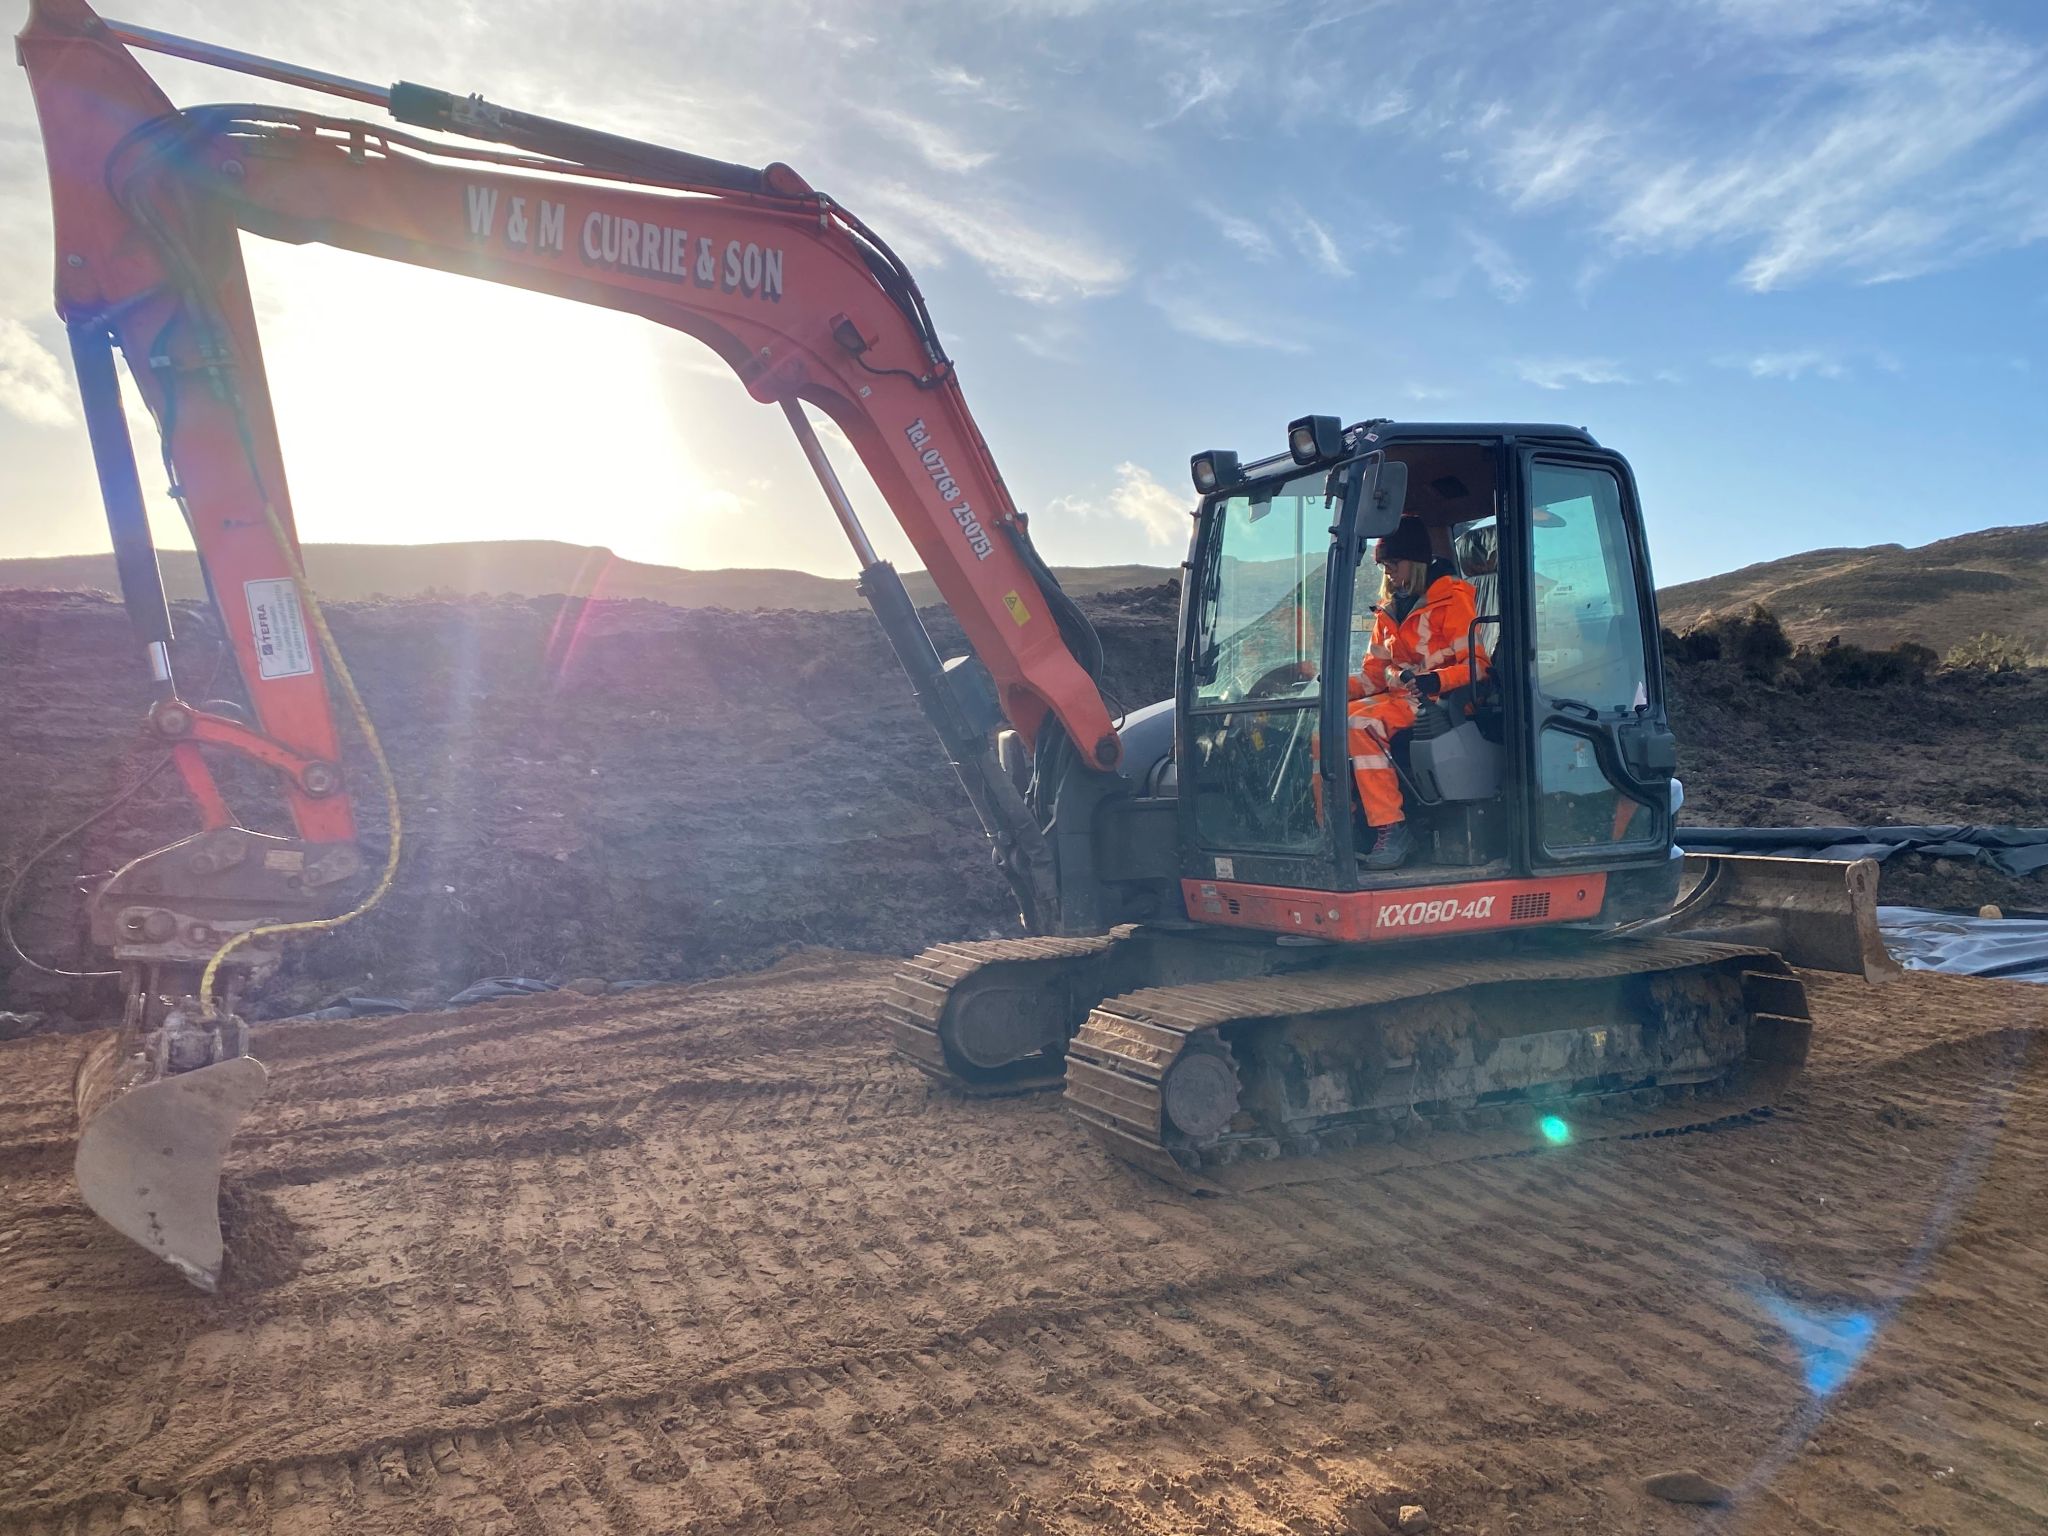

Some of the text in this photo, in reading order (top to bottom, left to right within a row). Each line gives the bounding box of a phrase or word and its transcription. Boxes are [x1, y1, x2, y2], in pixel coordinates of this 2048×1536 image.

[466, 184, 784, 295] W & M CURRIE & SON
[906, 418, 994, 561] Tel. 07768 250751
[257, 604, 272, 642] TEFRA
